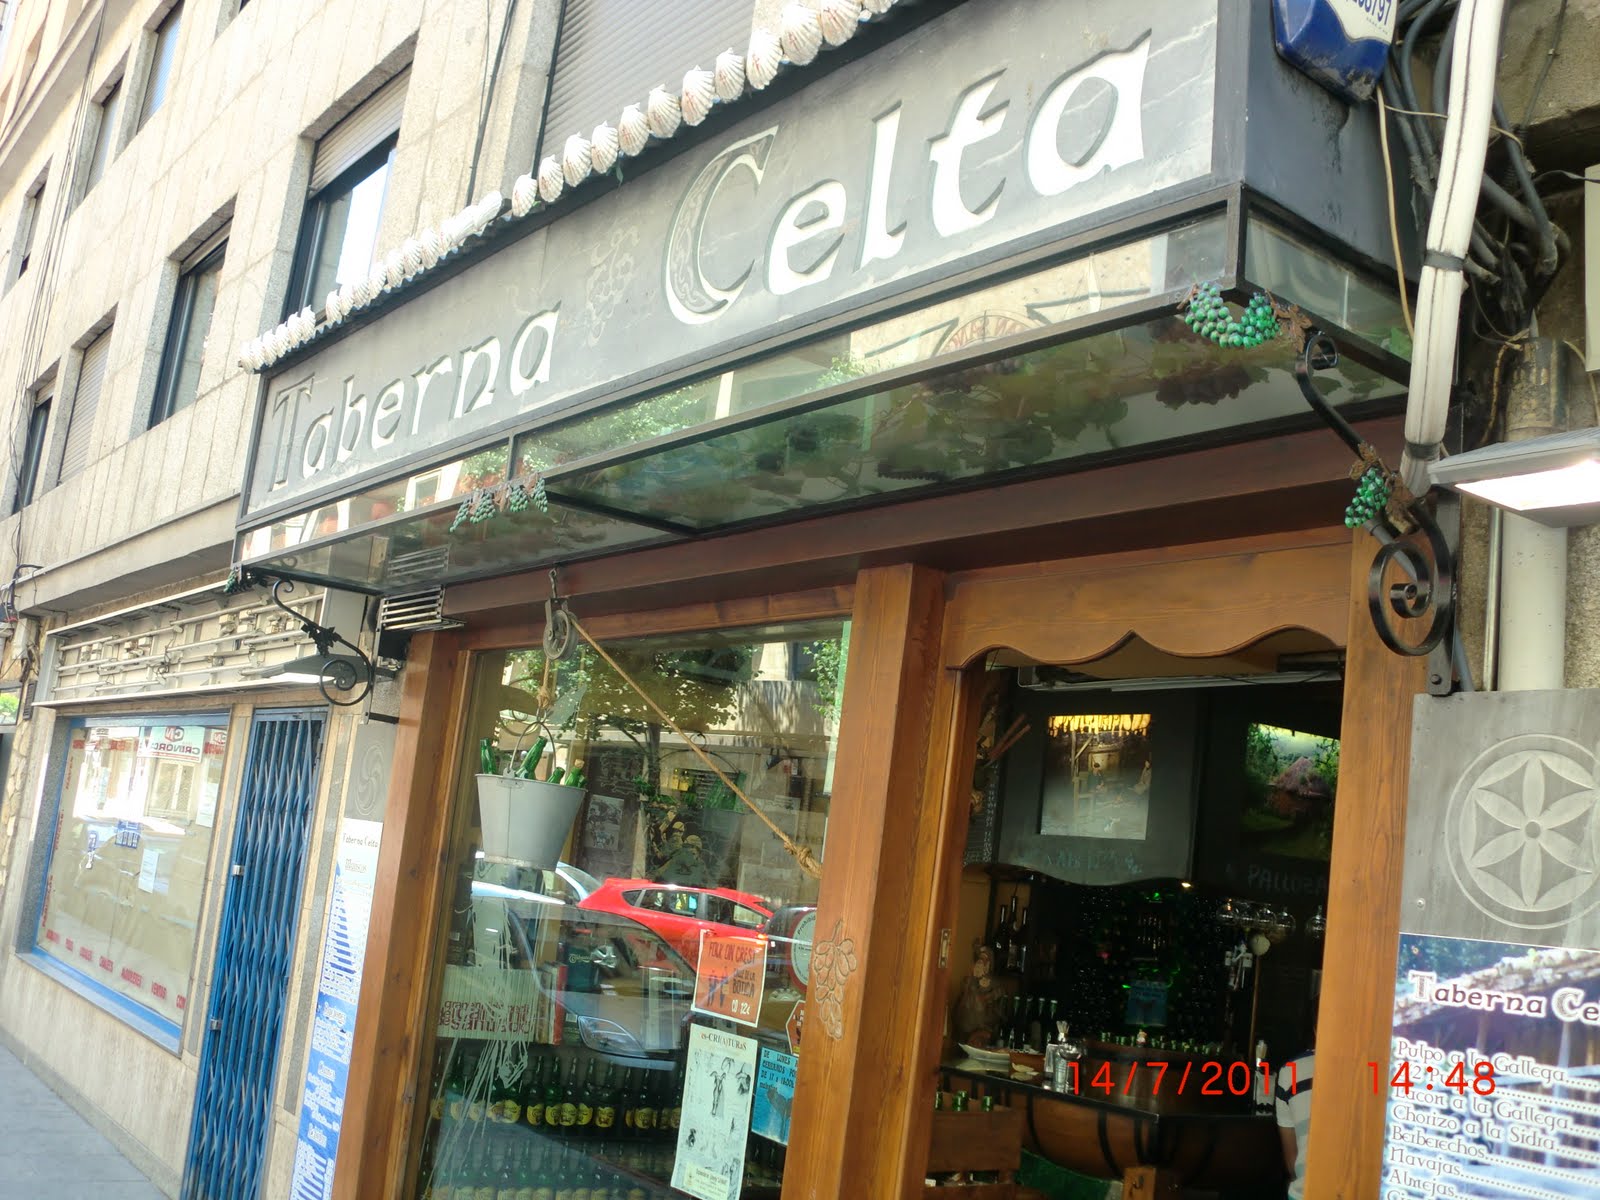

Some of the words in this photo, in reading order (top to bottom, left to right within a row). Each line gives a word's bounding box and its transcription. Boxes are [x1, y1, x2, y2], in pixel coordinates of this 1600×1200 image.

[269, 300, 561, 492] Taberna
[663, 28, 1151, 325] Celta
[1410, 972, 1544, 1016] Taberna
[1553, 989, 1600, 1023] Ce
[1398, 1040, 1443, 1065] Pulpo
[1450, 1053, 1461, 1065] a
[1494, 1055, 1565, 1084] Gallega
[1393, 1104, 1457, 1130] Chorizo
[1465, 1122, 1476, 1134] a
[1486, 1121, 1501, 1139] la
[1510, 1126, 1555, 1150] Sidra
[1452, 1098, 1463, 1110] a
[1473, 1096, 1488, 1114] la
[1496, 1101, 1569, 1132] Gallega
[1389, 1168, 1455, 1197] Almejas
[1390, 1146, 1461, 1176] Navajas
